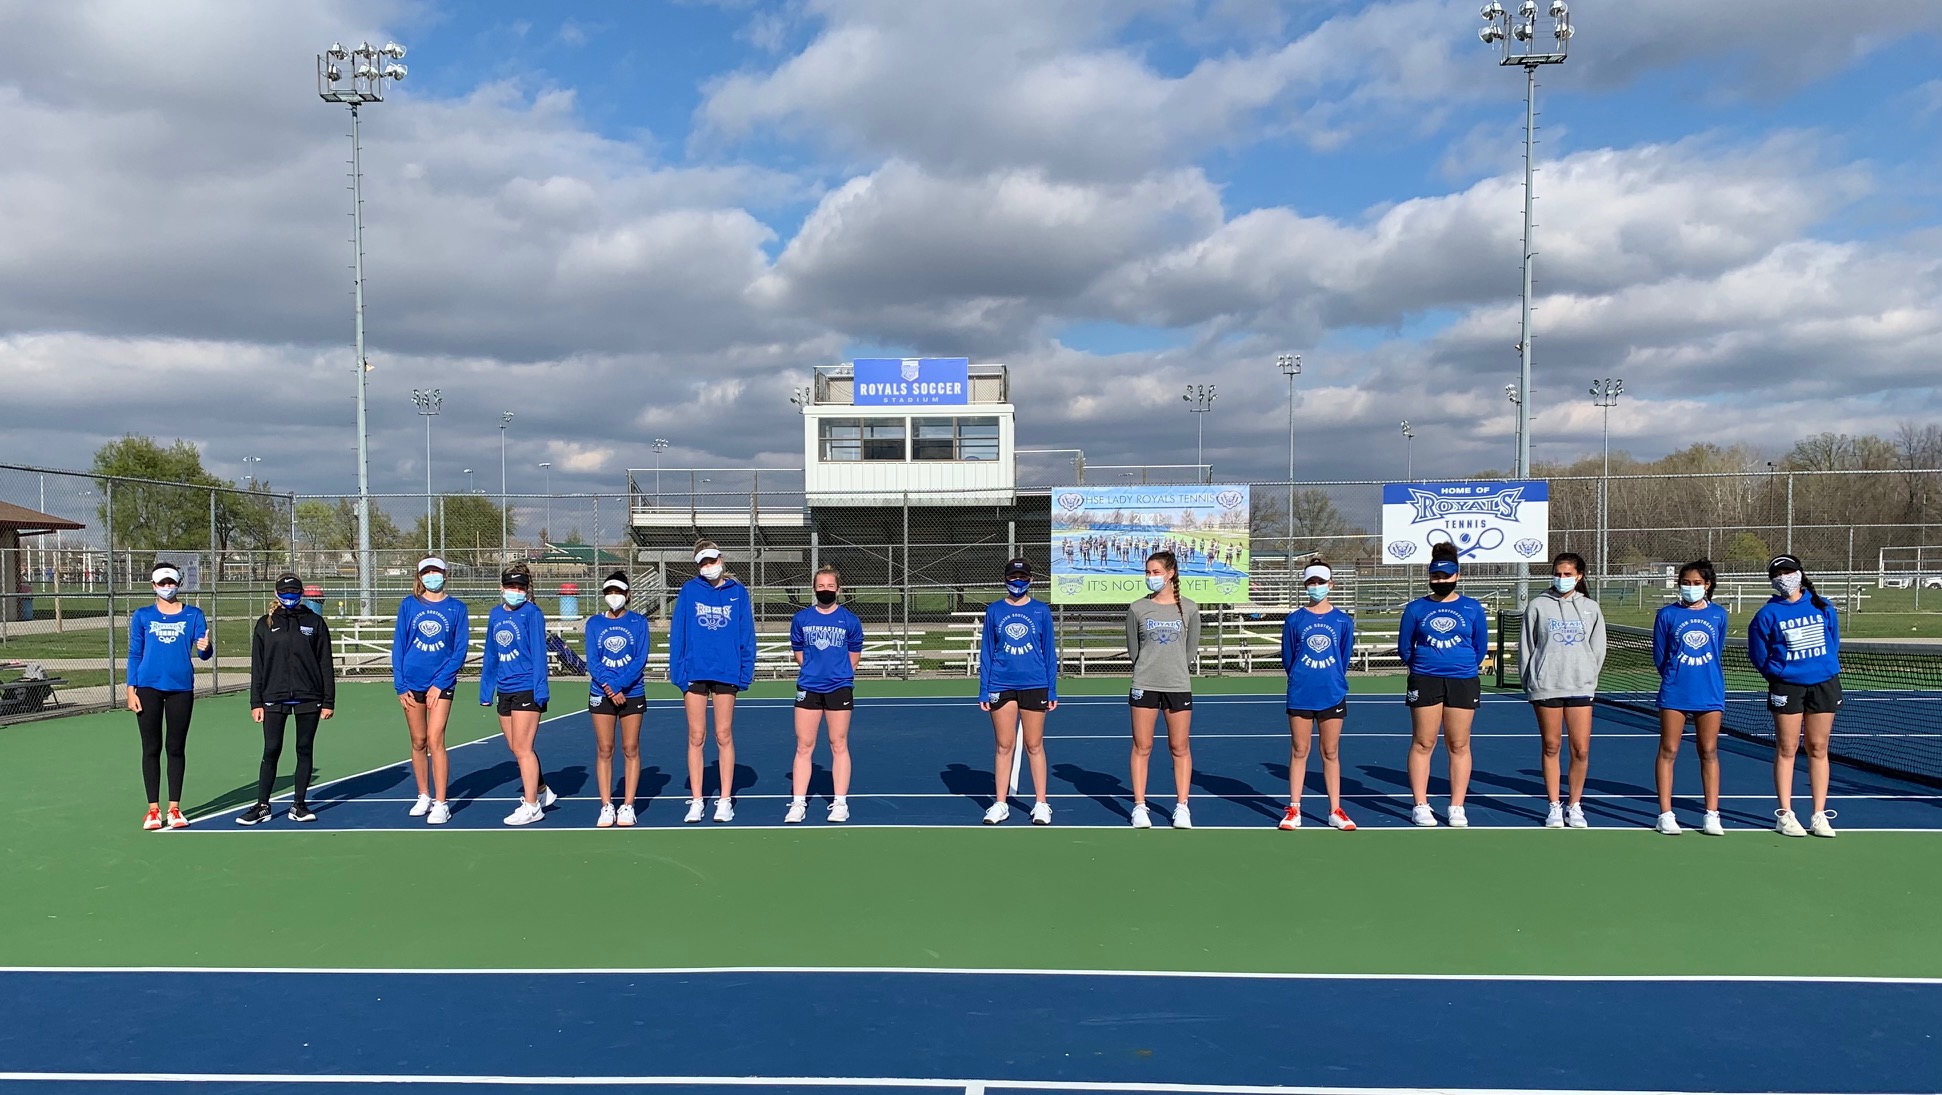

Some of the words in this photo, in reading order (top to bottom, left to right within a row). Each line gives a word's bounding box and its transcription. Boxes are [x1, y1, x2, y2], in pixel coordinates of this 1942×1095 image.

[860, 383, 907, 395] ROYALS
[912, 382, 962, 395] SOCCER
[1085, 495, 1104, 504] HSE
[1108, 495, 1133, 504] LADY
[1136, 494, 1175, 504] ROYALS
[1178, 493, 1215, 503] TENNIS
[1417, 492, 1516, 520] ROYALS
[1132, 513, 1161, 524] 2021
[1445, 520, 1486, 529] TENNIS
[1088, 580, 1107, 591] IT'S
[1112, 580, 1141, 591] NOT
[1186, 579, 1210, 591] YET
[1779, 614, 1825, 630] ROYALS
[413, 637, 445, 652] TENNIS
[1426, 634, 1462, 649] TENNIS
[497, 649, 520, 662] NNIS
[1677, 651, 1713, 666] TENNIS
[1786, 645, 1827, 661] NATION
[601, 654, 632, 667] TENNIS
[1301, 654, 1336, 669] TENNIS
